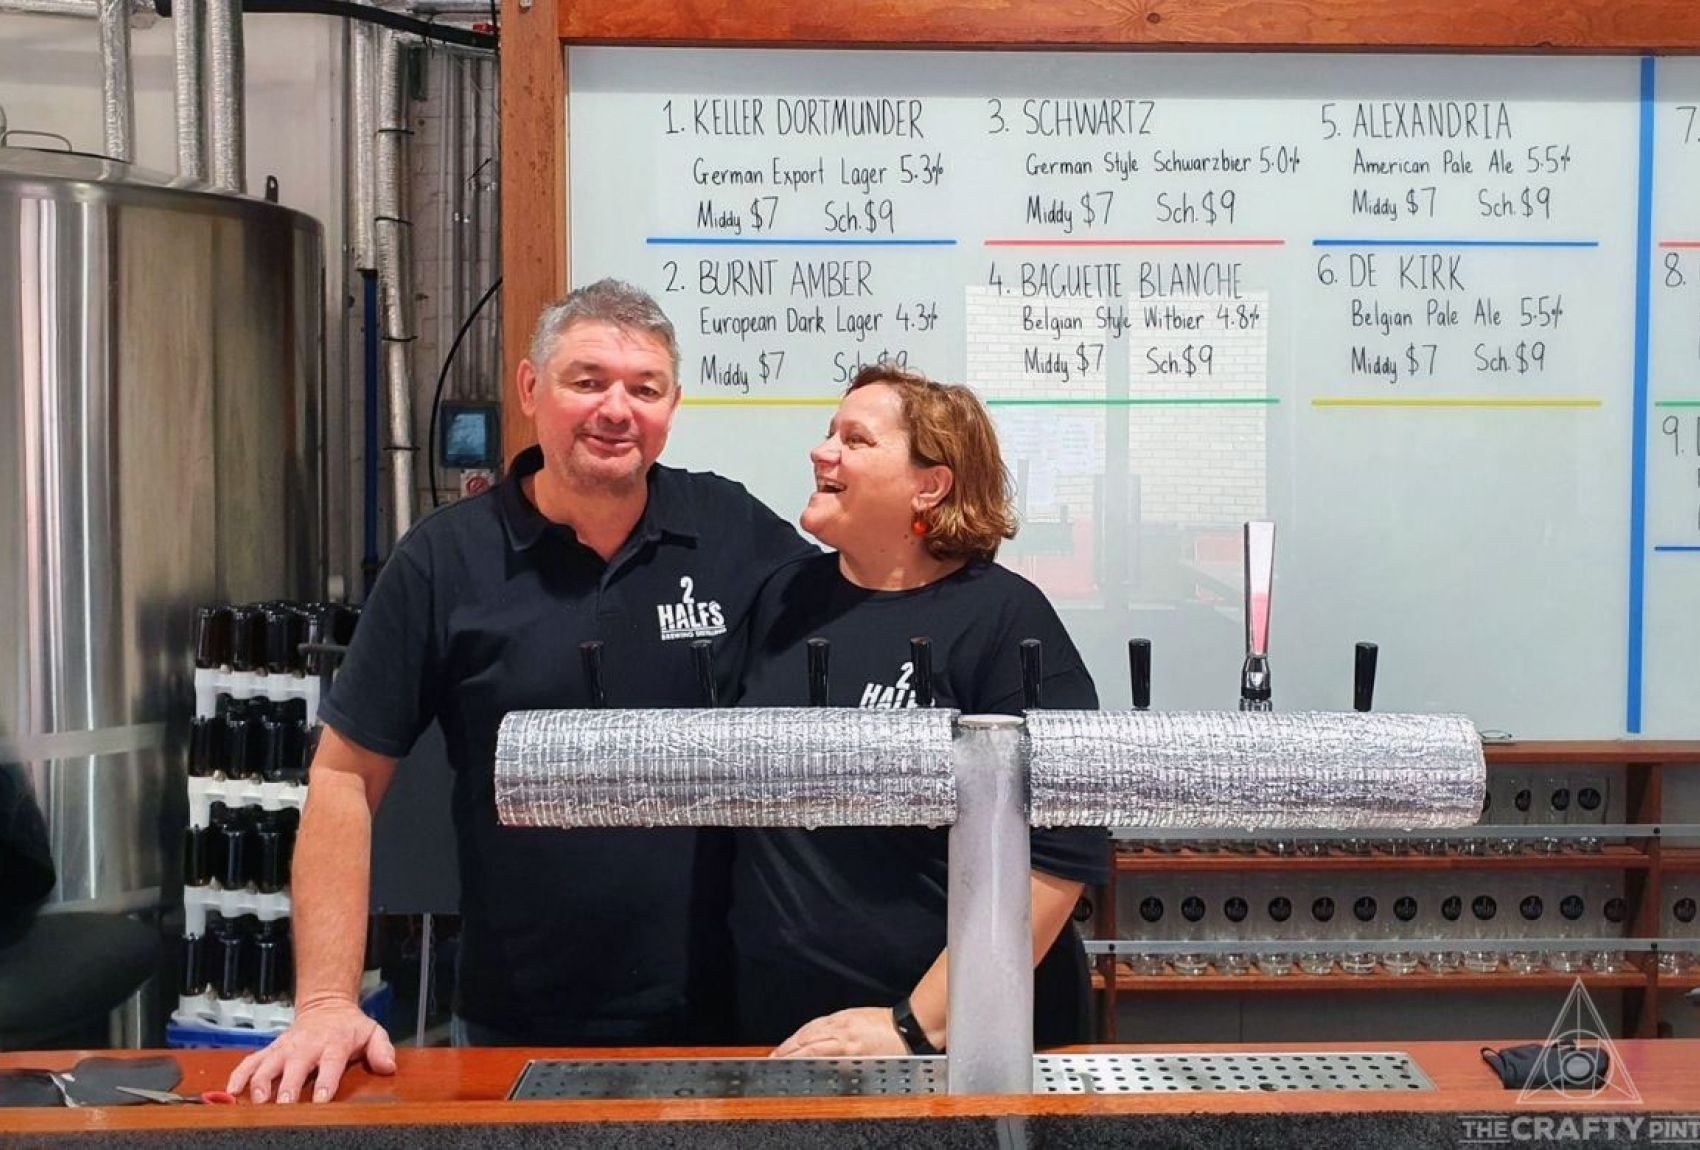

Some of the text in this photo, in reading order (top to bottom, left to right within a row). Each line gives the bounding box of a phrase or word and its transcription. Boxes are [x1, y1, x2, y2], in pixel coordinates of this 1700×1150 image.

[662, 98, 925, 140] 1. KELLER DORTMUNDER
[987, 98, 1156, 138] 3. SCHWARTZ
[1321, 102, 1512, 141] 5. ALEXANDRIA
[692, 156, 764, 187] German
[772, 156, 824, 193] Export
[840, 156, 888, 196] Lager
[1025, 152, 1093, 177] German
[1103, 150, 1140, 182] Style
[1153, 148, 1252, 173] Schwarzbier
[1352, 147, 1431, 175] American
[1442, 148, 1474, 175] Pale
[1488, 148, 1515, 175] Ale
[696, 199, 742, 236] Middy
[749, 195, 779, 232] $7
[1026, 194, 1074, 234] Middy
[1081, 190, 1114, 229] $7
[1352, 188, 1398, 222] Middy
[1406, 186, 1437, 218] $7
[662, 258, 874, 299] 2. BURNT AMBER
[988, 261, 1243, 300] 4. BAGUETTE BLANCHE
[1317, 253, 1465, 292] 6. DE KIRK
[1664, 252, 1686, 287] 8.
[699, 306, 777, 343] European
[786, 304, 827, 335] Dark
[836, 305, 884, 343] Lager
[1022, 304, 1083, 341] Belgian
[1095, 305, 1132, 340] Style
[1143, 305, 1205, 331] Witbier
[1351, 298, 1413, 337] Belgian
[1426, 298, 1459, 327] Pale
[1473, 297, 1502, 327] Ale
[700, 353, 750, 395] Middy
[758, 349, 786, 385] $7
[1024, 345, 1070, 384] Middy
[1076, 341, 1105, 378] $7
[1351, 345, 1398, 385] Middy
[1405, 341, 1438, 377] $7
[1663, 415, 1684, 456] 9.
[680, 575, 694, 603] 2
[657, 601, 725, 629] HALFS
[895, 661, 914, 690] 2
